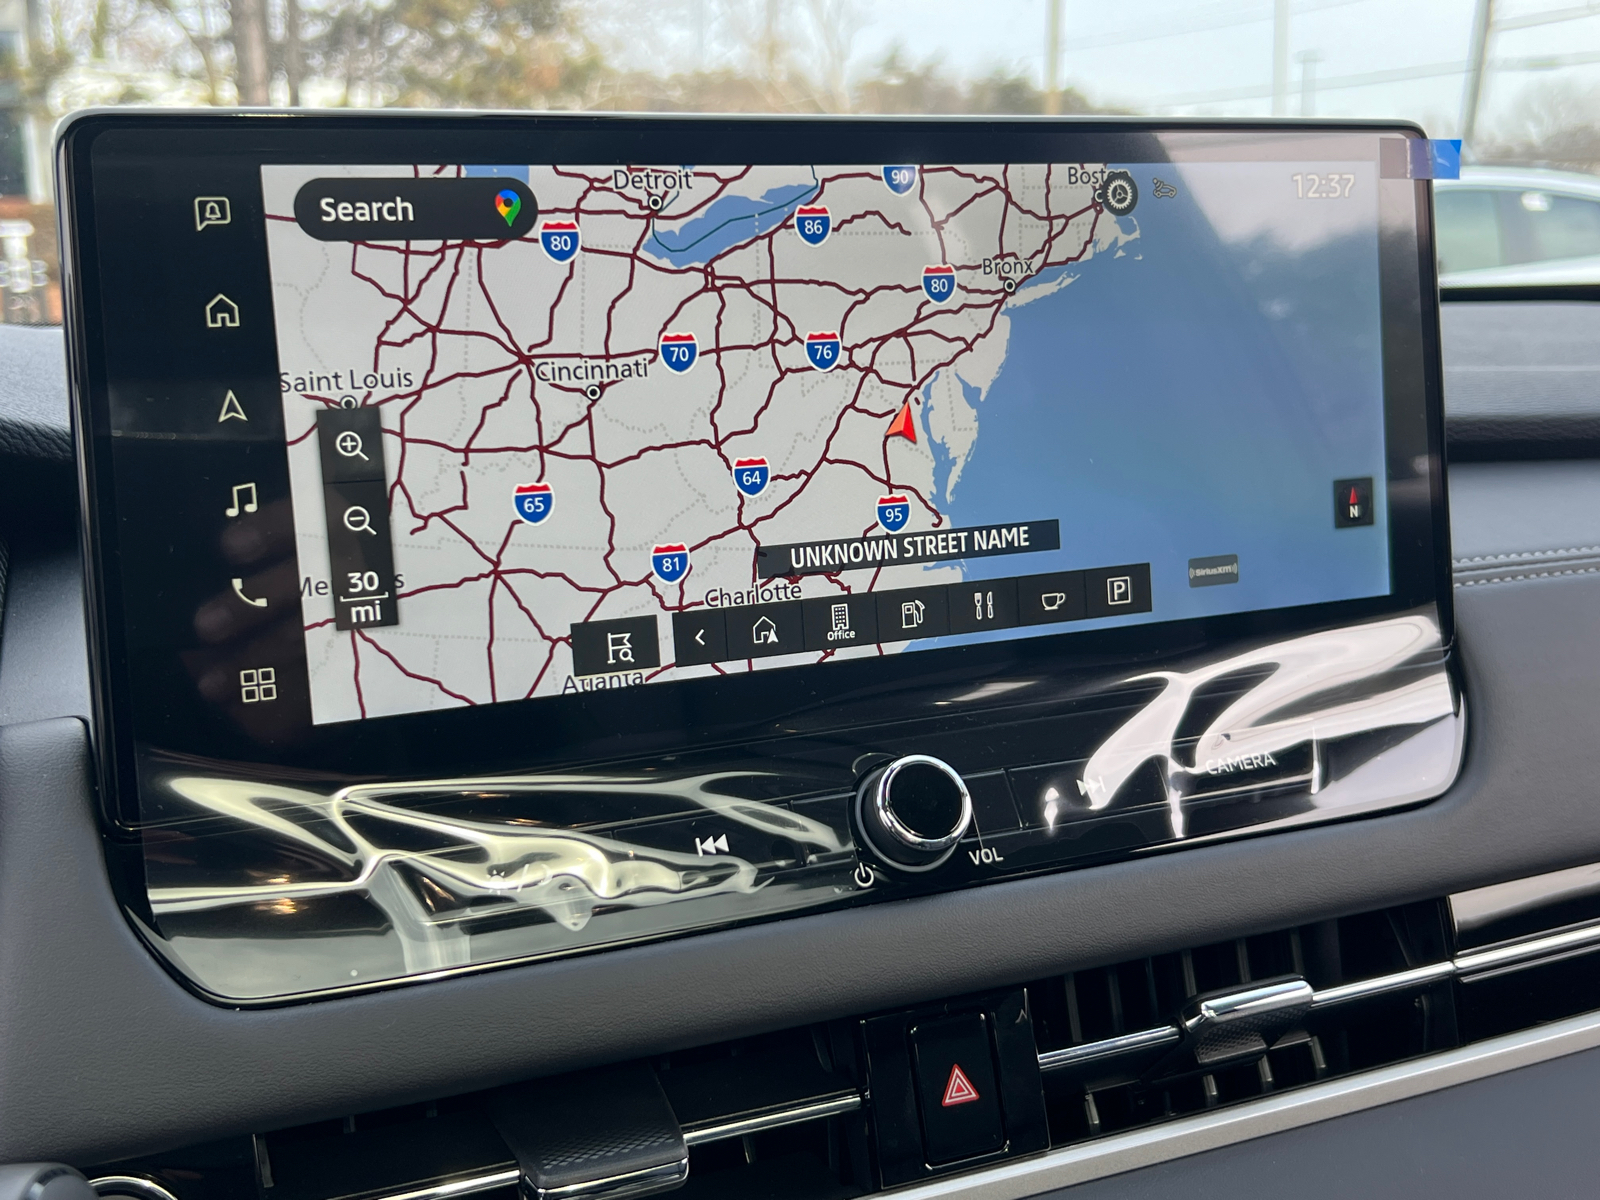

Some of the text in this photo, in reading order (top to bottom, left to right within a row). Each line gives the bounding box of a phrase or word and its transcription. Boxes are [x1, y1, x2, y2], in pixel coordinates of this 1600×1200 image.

[613, 169, 692, 190] Detroit
[891, 169, 909, 185] 90
[1068, 166, 1129, 185] Bost
[1292, 173, 1356, 198] 12:37
[320, 197, 415, 222] Search
[803, 218, 823, 236] 86
[549, 234, 572, 252] 80
[982, 257, 1033, 275] Bronx
[930, 277, 949, 294] 80
[670, 346, 690, 362] 70
[813, 343, 833, 360] 76
[535, 356, 649, 382] Cincinnati
[280, 367, 413, 393] Saint Louis
[742, 469, 762, 486] 64
[523, 496, 545, 514] 65
[885, 507, 903, 523] 95
[791, 526, 1030, 569] UNKNOWN STREET NAME
[662, 556, 682, 573] 81
[347, 571, 380, 593] 30
[705, 583, 802, 608] Charlotte
[350, 600, 382, 623] mi
[827, 628, 856, 642] Office
[1205, 752, 1276, 774] CAMERA
[968, 847, 1003, 865] VOL
